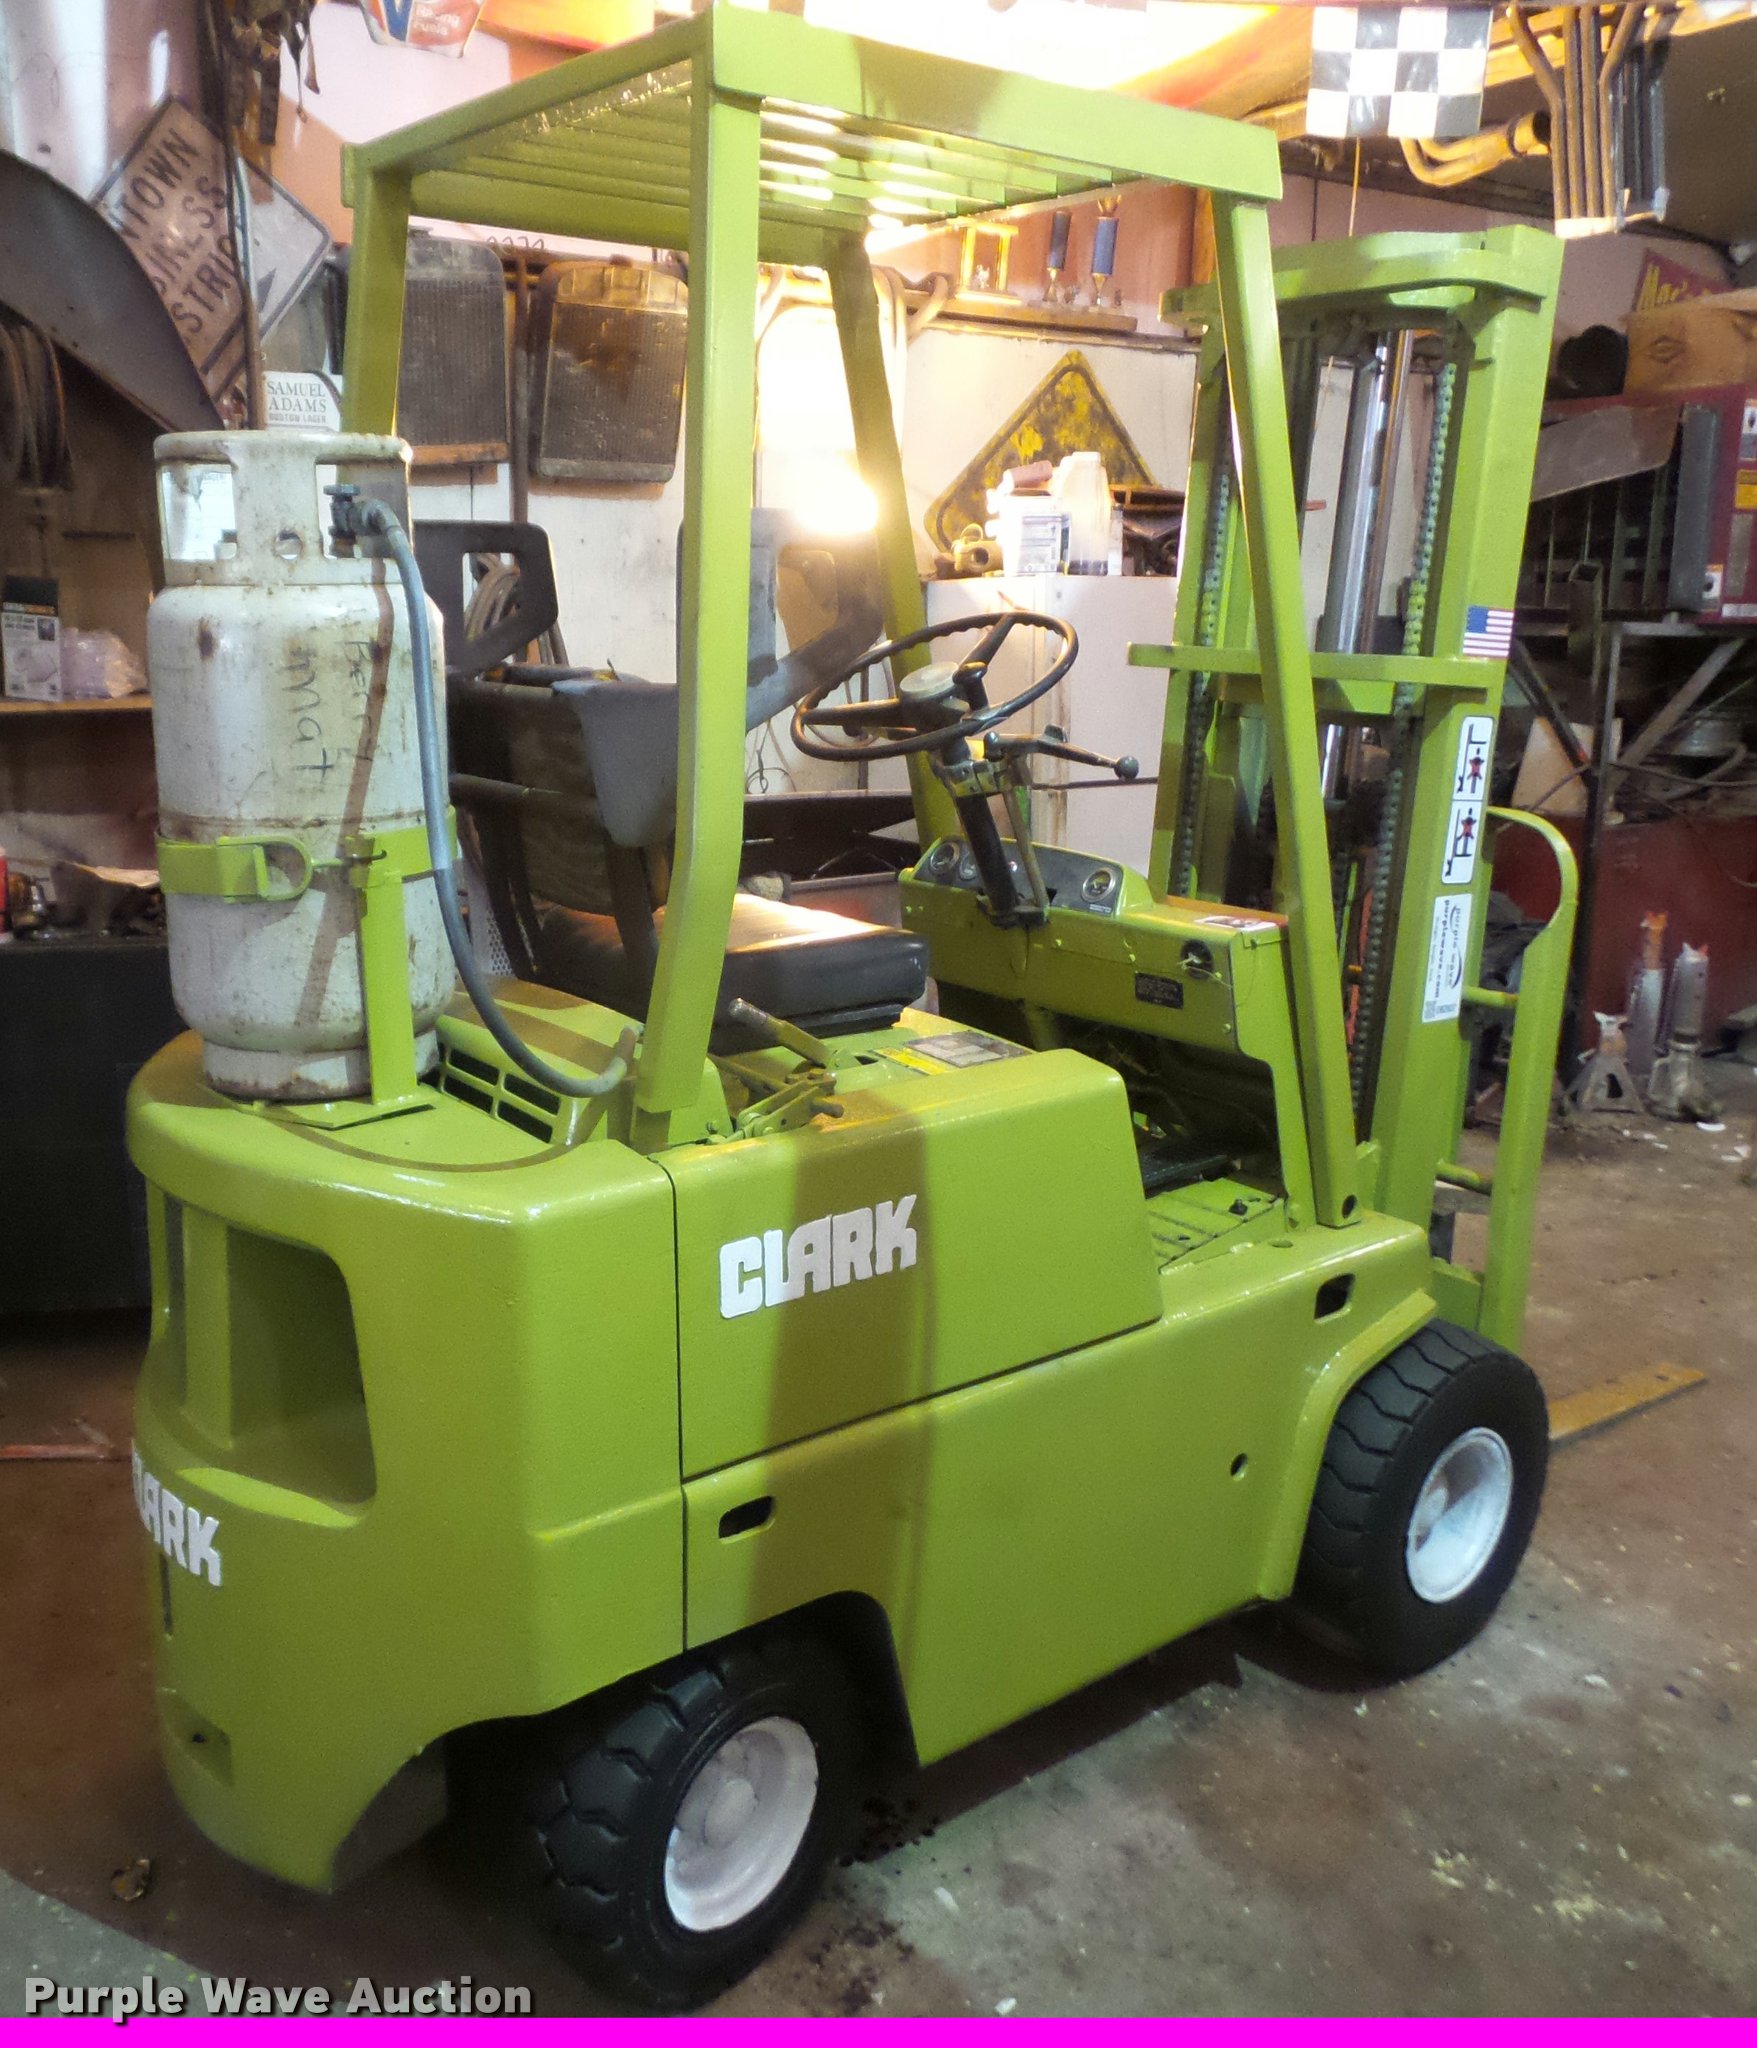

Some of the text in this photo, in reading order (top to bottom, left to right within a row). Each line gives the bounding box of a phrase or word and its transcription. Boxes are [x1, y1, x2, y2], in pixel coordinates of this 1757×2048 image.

[267, 381, 326, 397] SAMUEL
[268, 397, 327, 413] ADAMS
[719, 1194, 917, 1319] CLARK
